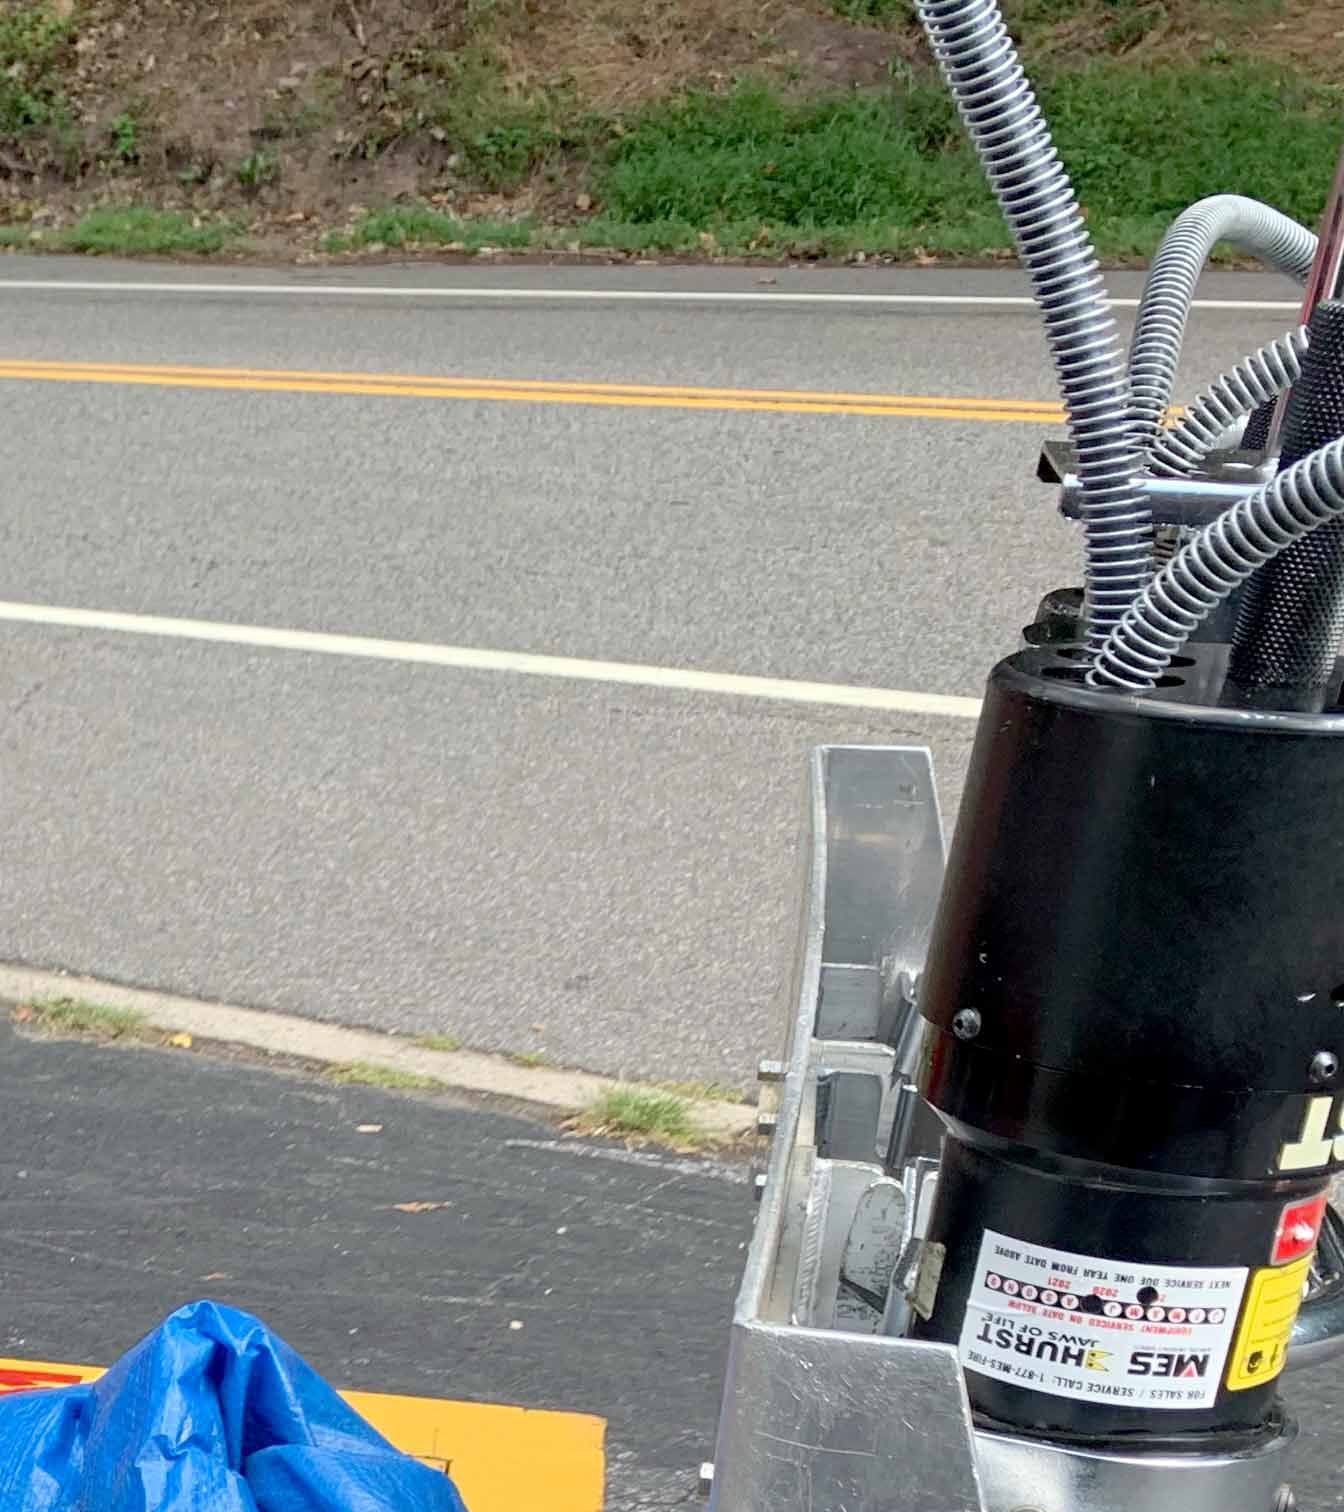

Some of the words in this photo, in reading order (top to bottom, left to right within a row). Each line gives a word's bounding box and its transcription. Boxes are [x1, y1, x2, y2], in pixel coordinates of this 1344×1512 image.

[993, 1245, 1022, 1261] ABOVE
[1024, 1255, 1047, 1268] DATE
[1051, 1261, 1080, 1276] FROM
[1082, 1268, 1109, 1281] YEAR
[1047, 1277, 1072, 1290] 2021
[1113, 1273, 1135, 1284] ONE
[1140, 1277, 1159, 1286] DUE
[1165, 1279, 1204, 1289] SERVICE
[1208, 1280, 1232, 1289] NEXT
[1092, 1286, 1120, 1297] 2020
[1008, 1300, 1037, 1314] BELOW
[1042, 1308, 1065, 1321] DATE
[1069, 1315, 1083, 1325] ON
[1018, 1324, 1043, 1336] OF
[1088, 1317, 1135, 1332] SERVICED
[976, 1323, 1086, 1368] HURST
[1048, 1331, 1100, 1347] JAWS
[968, 1350, 1044, 1382] 1-877-MES-FIRE
[1127, 1352, 1210, 1377] MES
[1087, 1382, 1135, 1396] SERVICE
[1150, 1389, 1182, 1400] SALES
[1187, 1390, 1206, 1400] FOR
